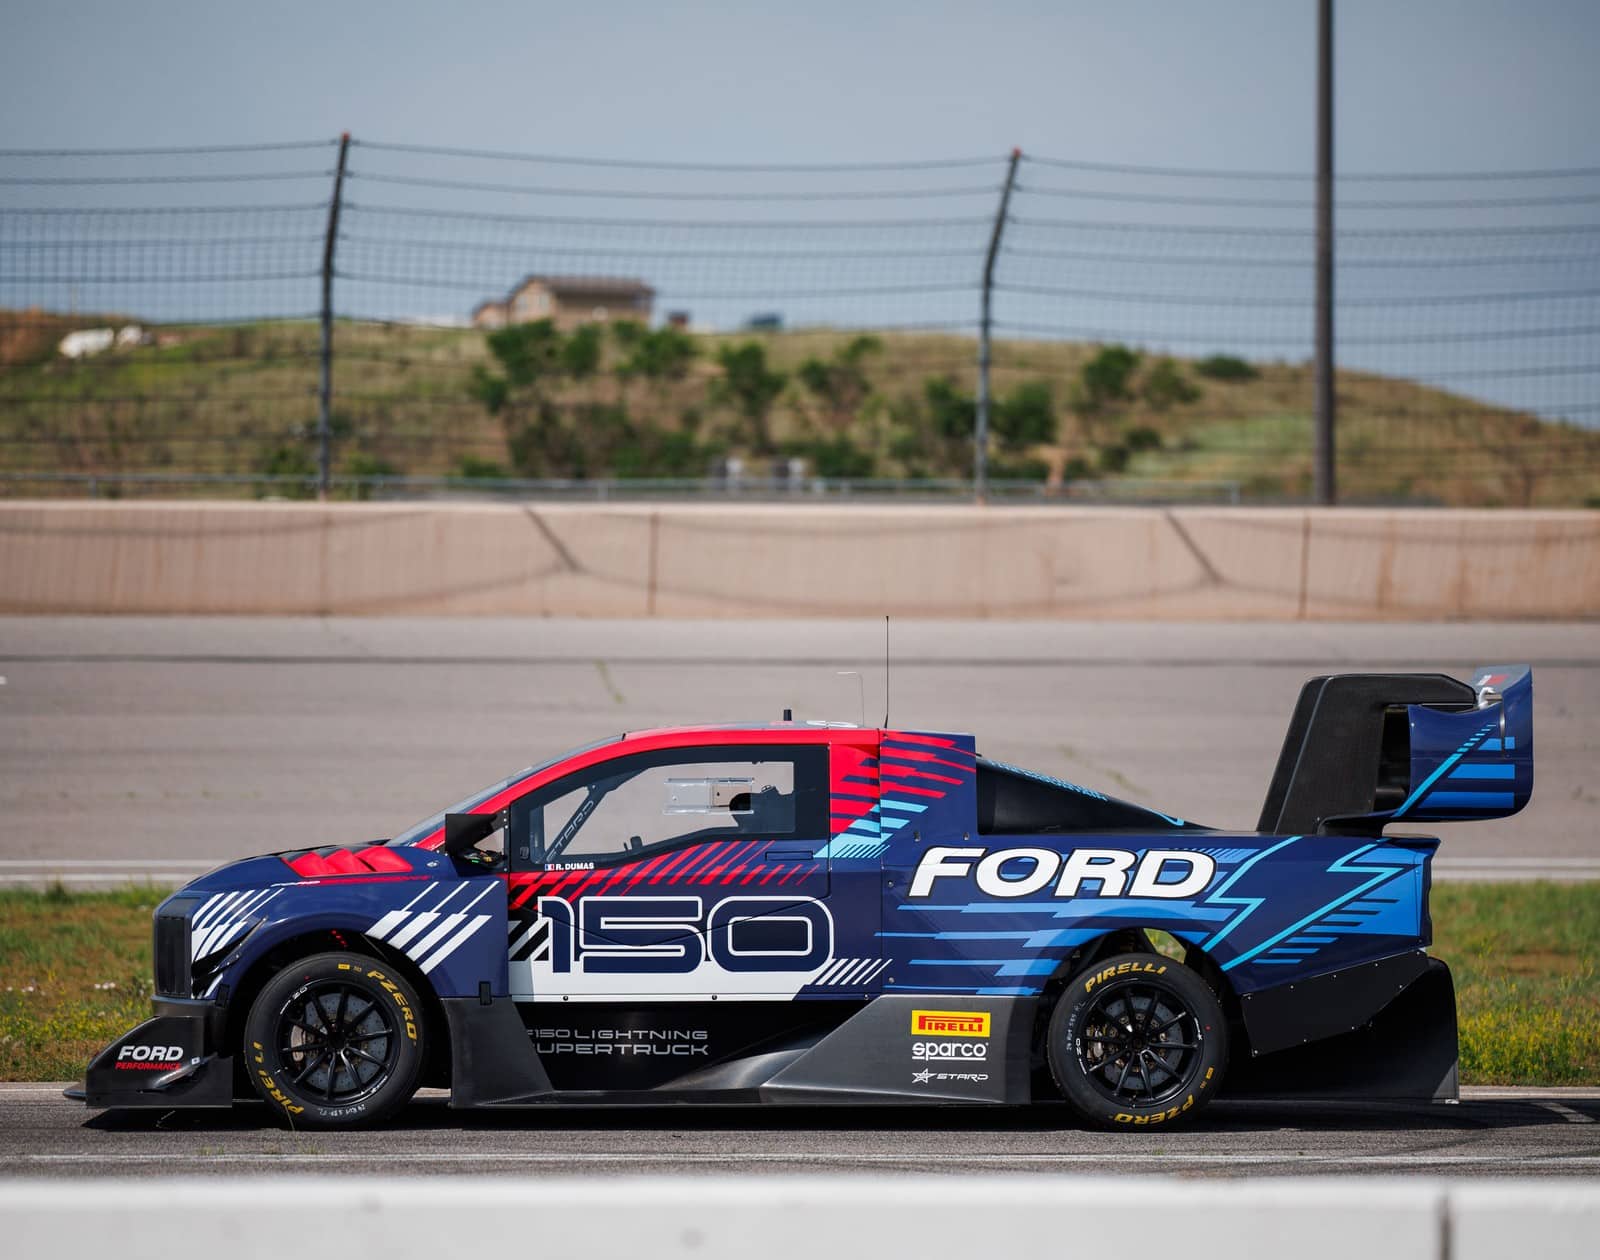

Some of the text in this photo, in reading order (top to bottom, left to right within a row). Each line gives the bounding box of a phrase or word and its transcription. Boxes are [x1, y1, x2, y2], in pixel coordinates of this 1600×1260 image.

[565, 863, 595, 871] DUMAS
[908, 846, 1217, 899] FORD
[537, 896, 834, 974] 150
[1084, 961, 1167, 993] PIRELLI
[367, 970, 417, 1041] PZERO
[918, 1015, 984, 1033] PIRELLI
[574, 1030, 708, 1040] LIGHTNING
[118, 1045, 184, 1061] FORD
[533, 1043, 709, 1056] UPERTRUCK
[911, 1042, 987, 1061] sparco
[115, 1062, 181, 1071] PERFORMANCE
[936, 1073, 989, 1082] STARD
[1114, 1094, 1195, 1125] PZERO
